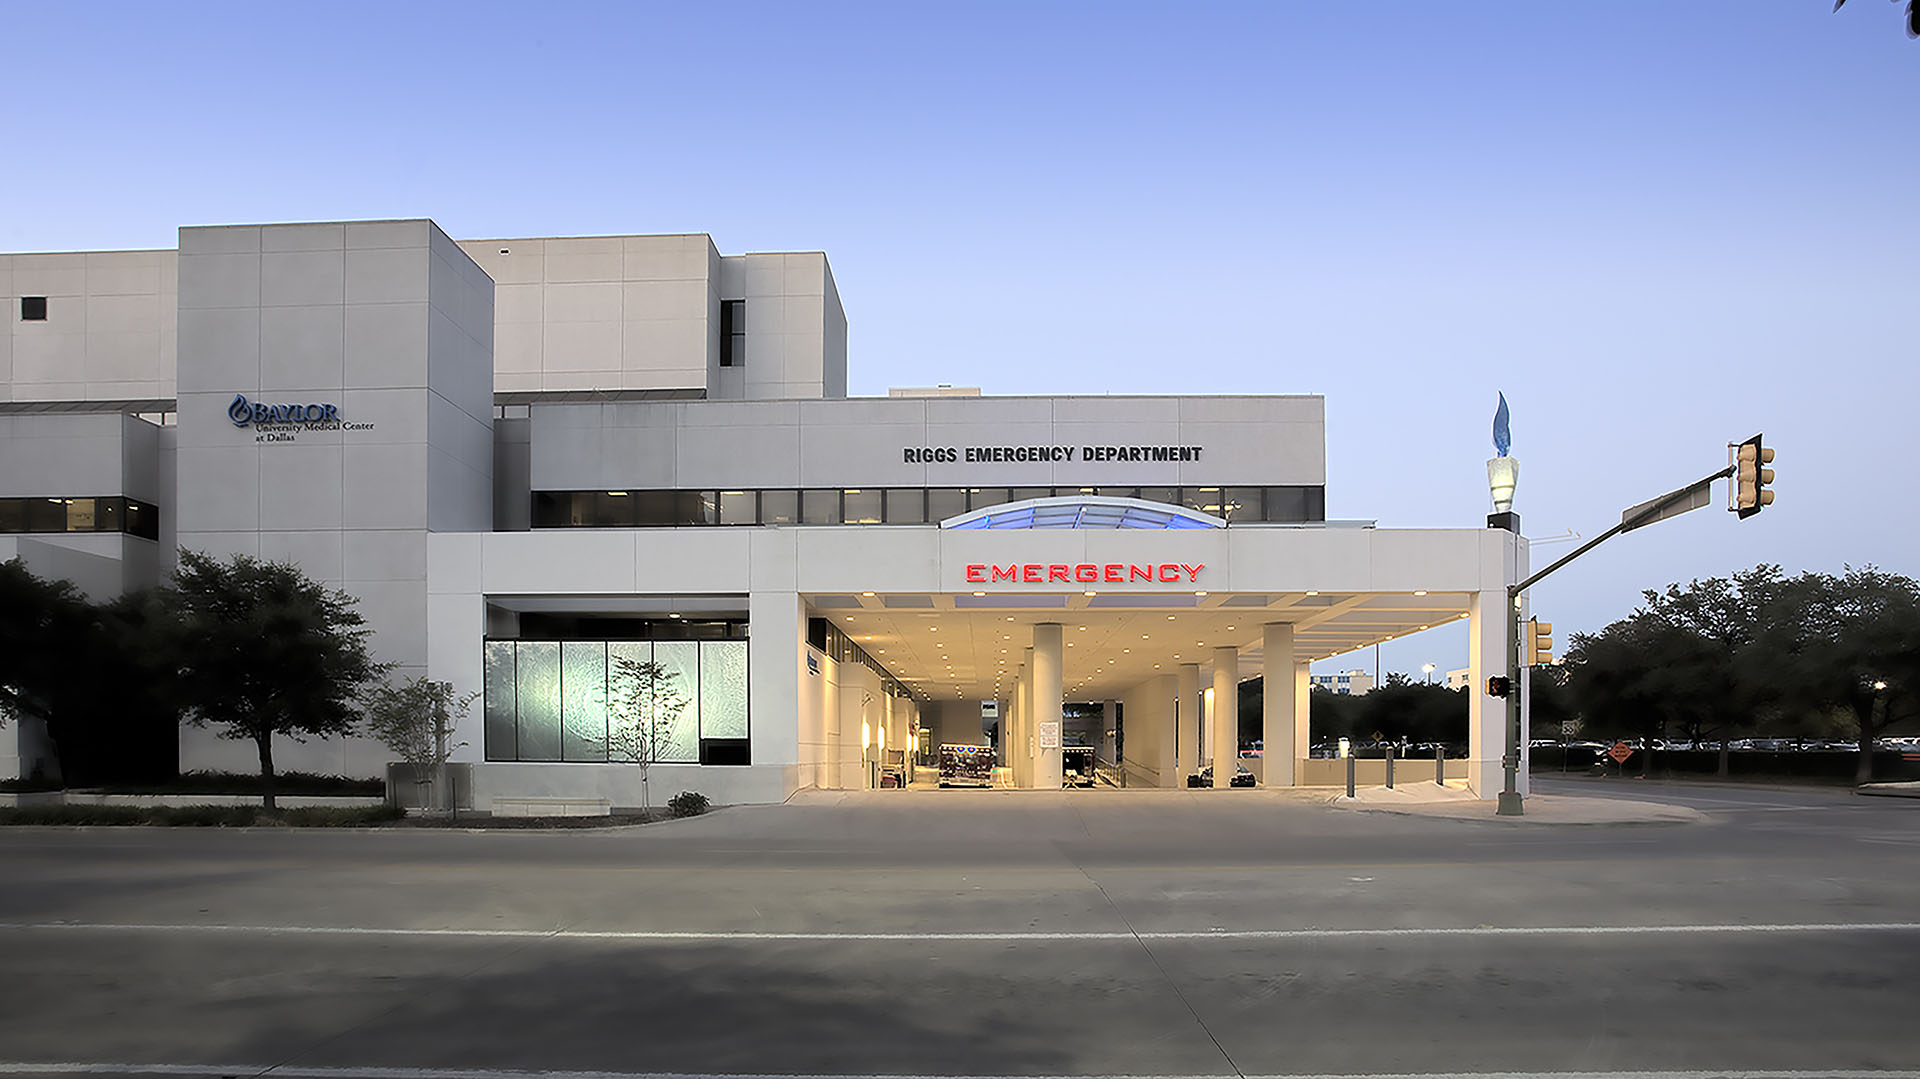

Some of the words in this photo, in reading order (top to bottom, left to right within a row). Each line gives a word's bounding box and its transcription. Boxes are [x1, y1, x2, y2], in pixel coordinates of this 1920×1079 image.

[252, 402, 341, 423] BAYLOR
[255, 423, 302, 434] University
[304, 422, 340, 431] Medical
[342, 421, 375, 431] Center
[255, 434, 264, 442] at
[267, 433, 295, 442] Dallas
[903, 447, 957, 463] RIGGS
[965, 446, 1075, 463] EMERGENCY
[1083, 446, 1203, 462] DEPARTMENT
[965, 563, 1206, 583] EMERGENCY
